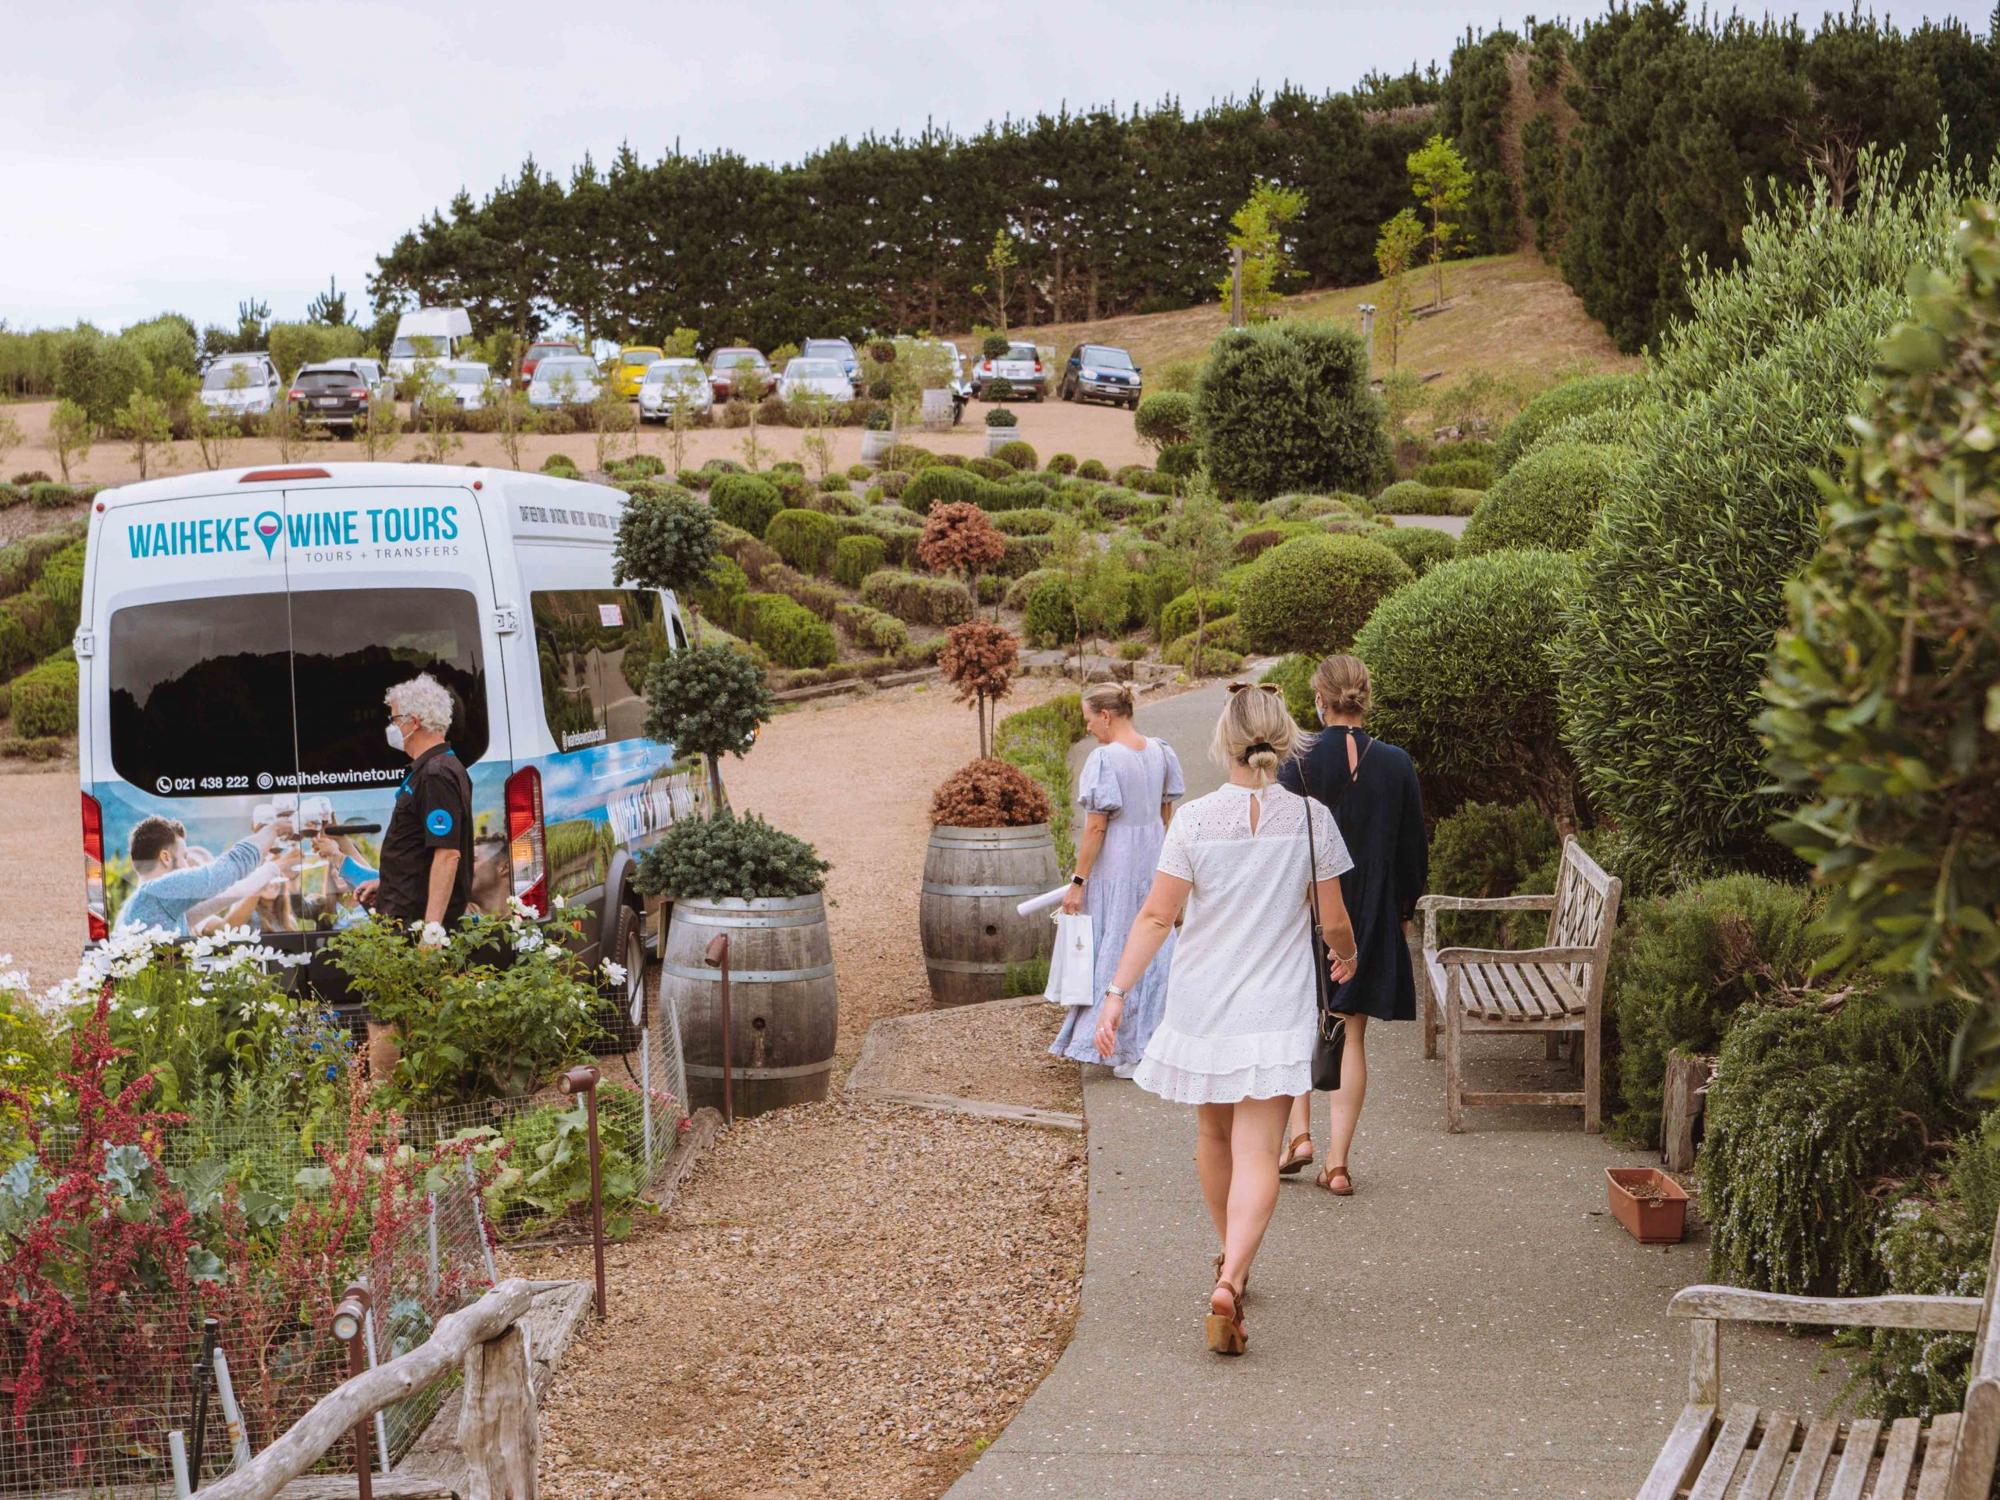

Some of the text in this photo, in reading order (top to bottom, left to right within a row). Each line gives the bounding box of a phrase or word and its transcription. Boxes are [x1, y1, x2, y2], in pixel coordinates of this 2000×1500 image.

[127, 505, 458, 559] WAIHEKE WINE TOURS
[306, 551, 353, 563] TOURS
[376, 545, 460, 559] TRANSFERS
[174, 777, 196, 791] 021
[199, 776, 223, 790] 438
[225, 775, 249, 789] 222
